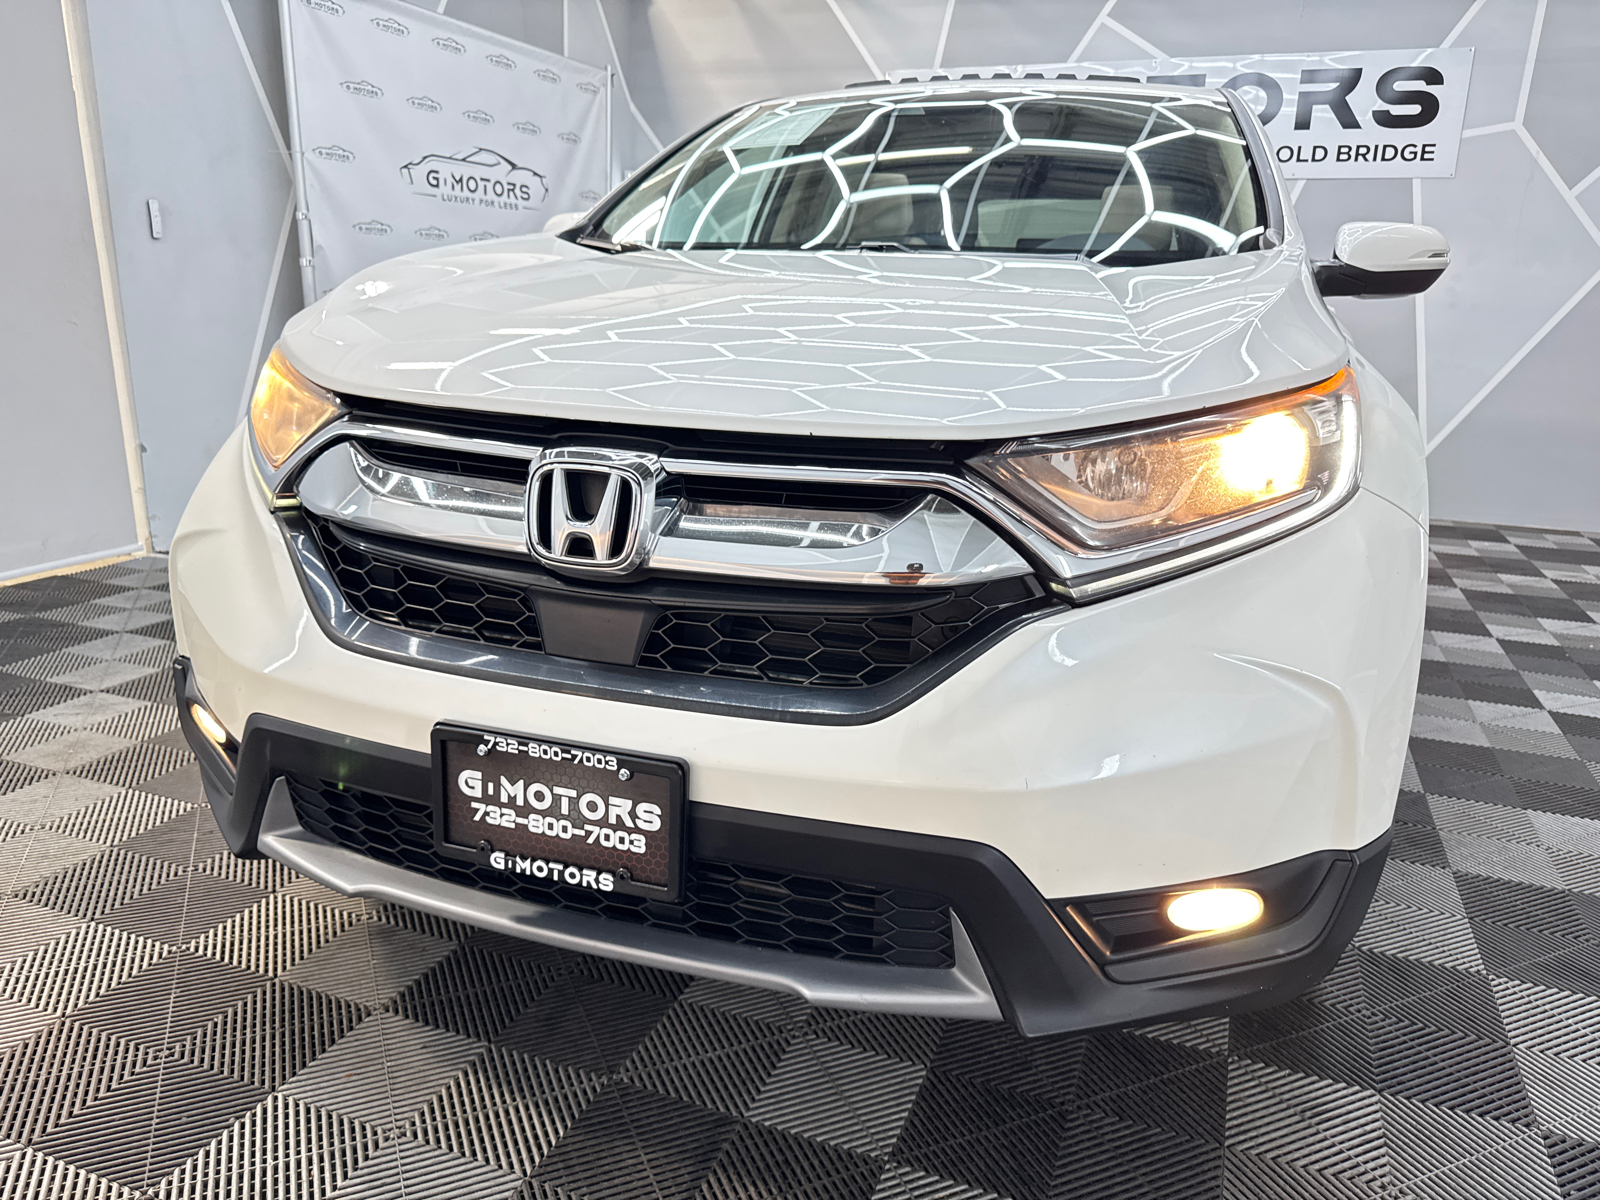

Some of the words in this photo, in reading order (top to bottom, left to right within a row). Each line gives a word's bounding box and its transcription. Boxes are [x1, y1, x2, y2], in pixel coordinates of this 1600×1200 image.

[1276, 144, 1328, 164] OLD
[1335, 143, 1437, 163] BRIDGE
[441, 193, 476, 206] LUXURY
[479, 198, 496, 209] FOR
[498, 200, 520, 212] LESS
[482, 734, 618, 771] 732-800-7003
[470, 801, 646, 855] 732-800-7003
